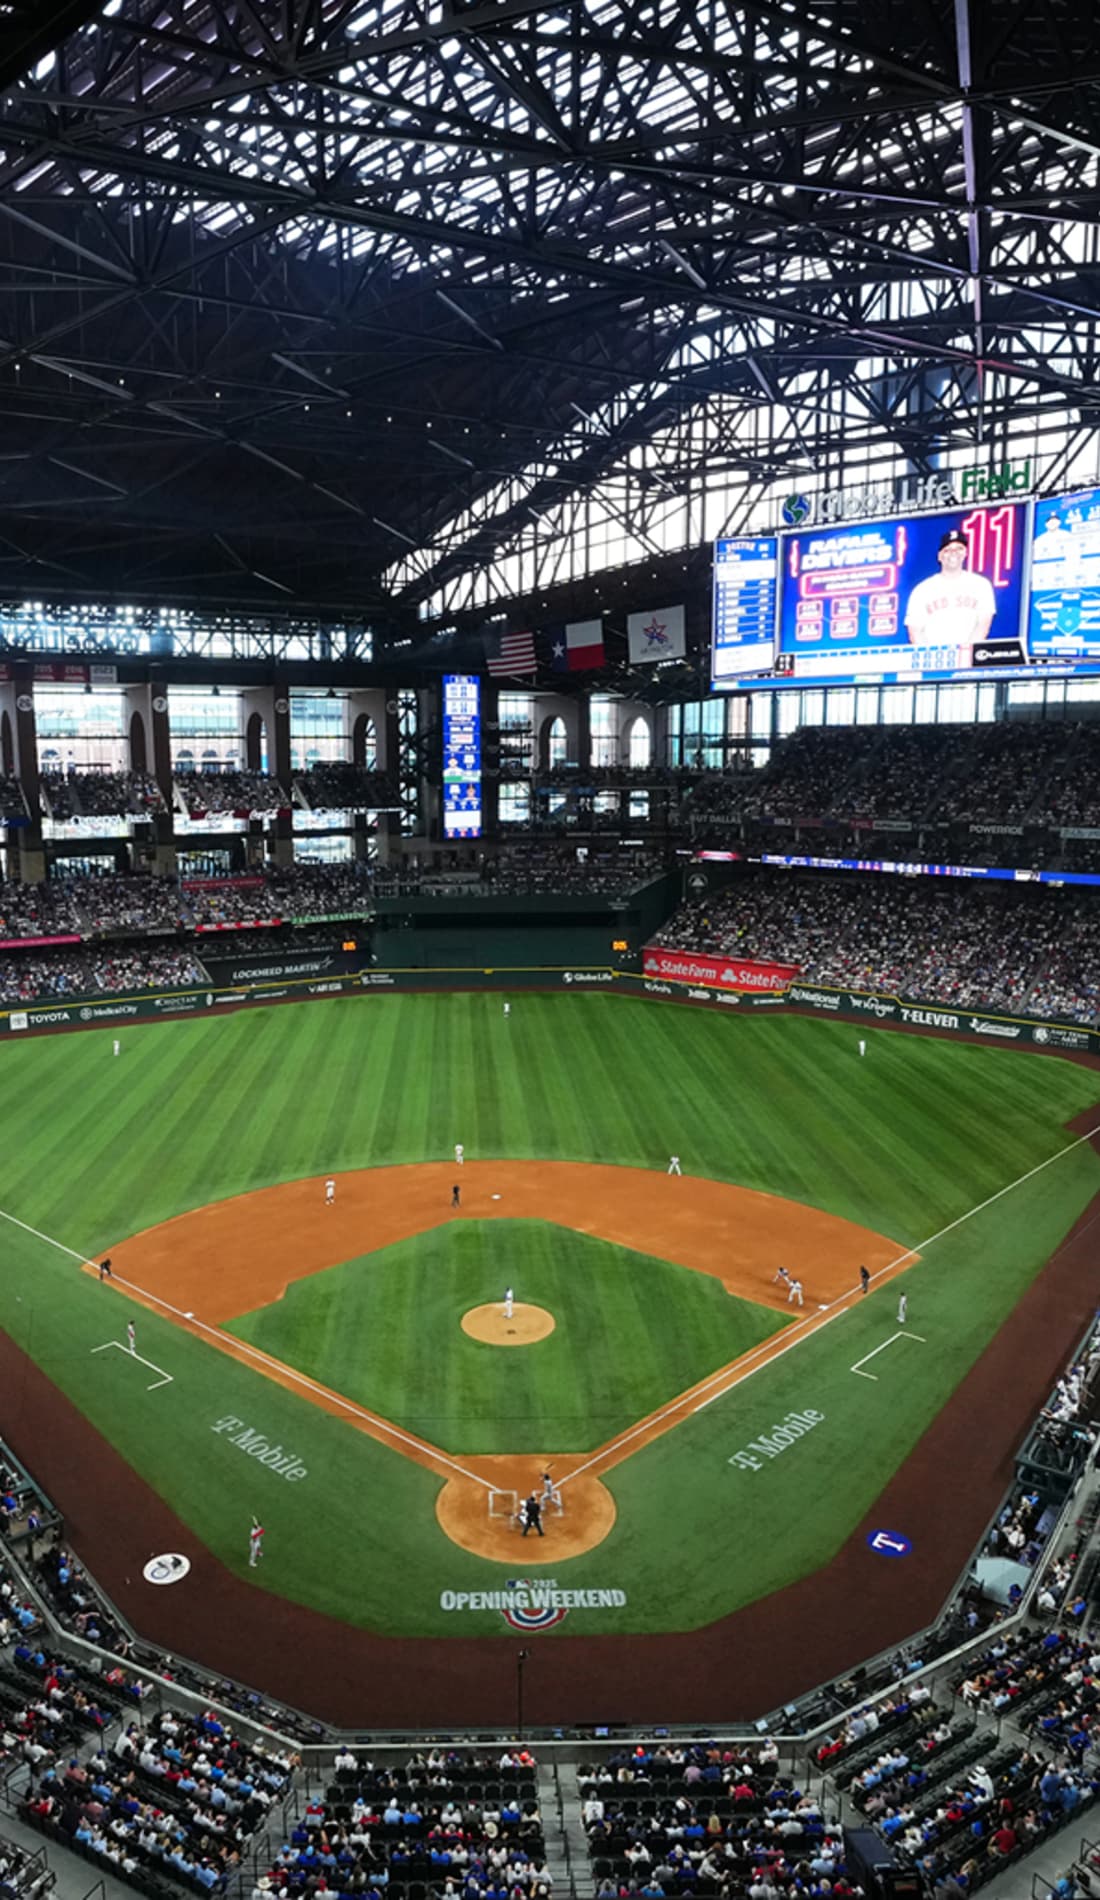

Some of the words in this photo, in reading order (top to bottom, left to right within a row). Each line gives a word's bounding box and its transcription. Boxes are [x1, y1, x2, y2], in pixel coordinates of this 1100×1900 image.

[817, 489, 895, 518] Globe
[901, 474, 952, 505] Life
[961, 461, 1030, 499] Field
[962, 506, 1014, 587] 11
[969, 824, 1025, 836] POWERADE
[232, 967, 283, 979] LOCKHEED
[284, 962, 321, 974] MARTIN
[801, 990, 841, 1005] National
[863, 996, 896, 1018] Kroger
[29, 1011, 70, 1024] TOYOTA
[746, 1408, 825, 1458] Mobile
[227, 1428, 308, 1482] Mobile
[532, 1578, 558, 1589] 2025
[439, 1589, 529, 1610] OPENING
[529, 1588, 627, 1609] WEEKEND
